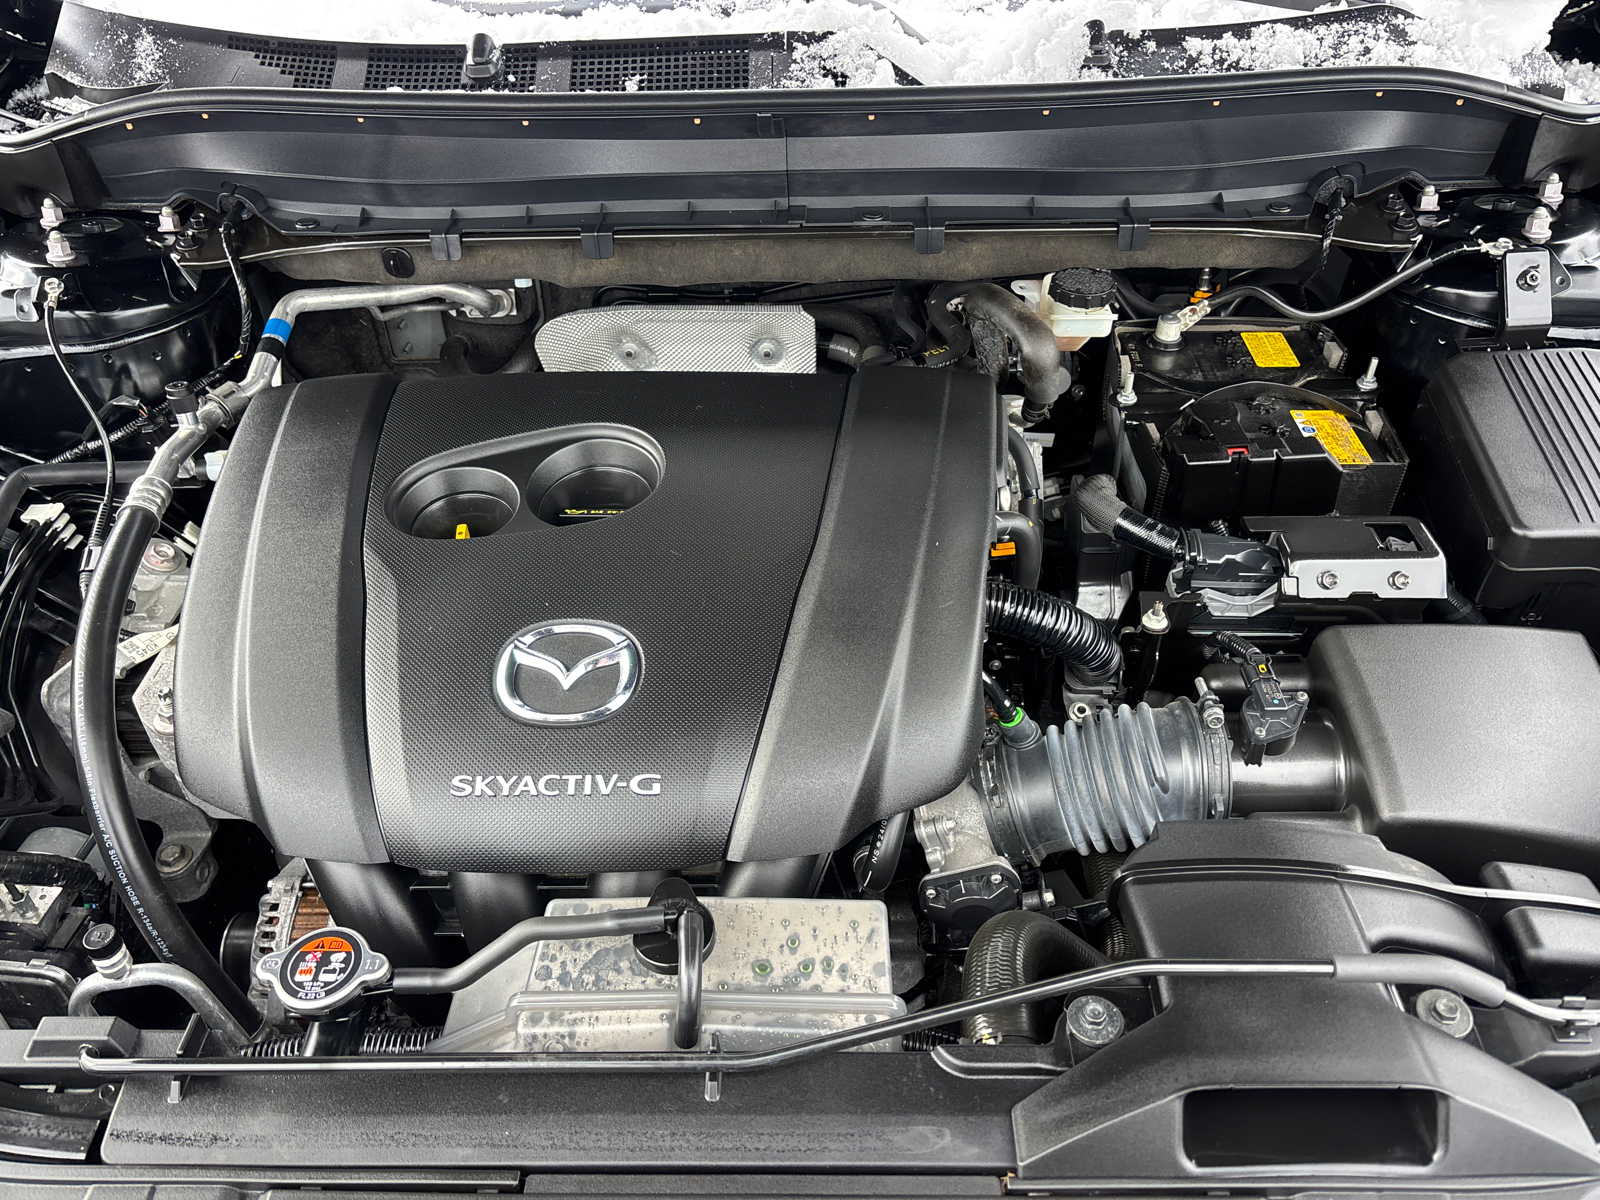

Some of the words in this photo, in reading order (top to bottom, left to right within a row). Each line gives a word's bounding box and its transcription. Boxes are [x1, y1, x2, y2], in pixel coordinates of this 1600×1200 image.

[78, 733, 90, 765] (16mm)
[88, 787, 106, 832] Flexbarrier
[101, 832, 113, 849] A/C
[107, 848, 129, 886] SUCTION
[124, 884, 141, 907] HOSE
[450, 773, 662, 797] SKYACTIV-G
